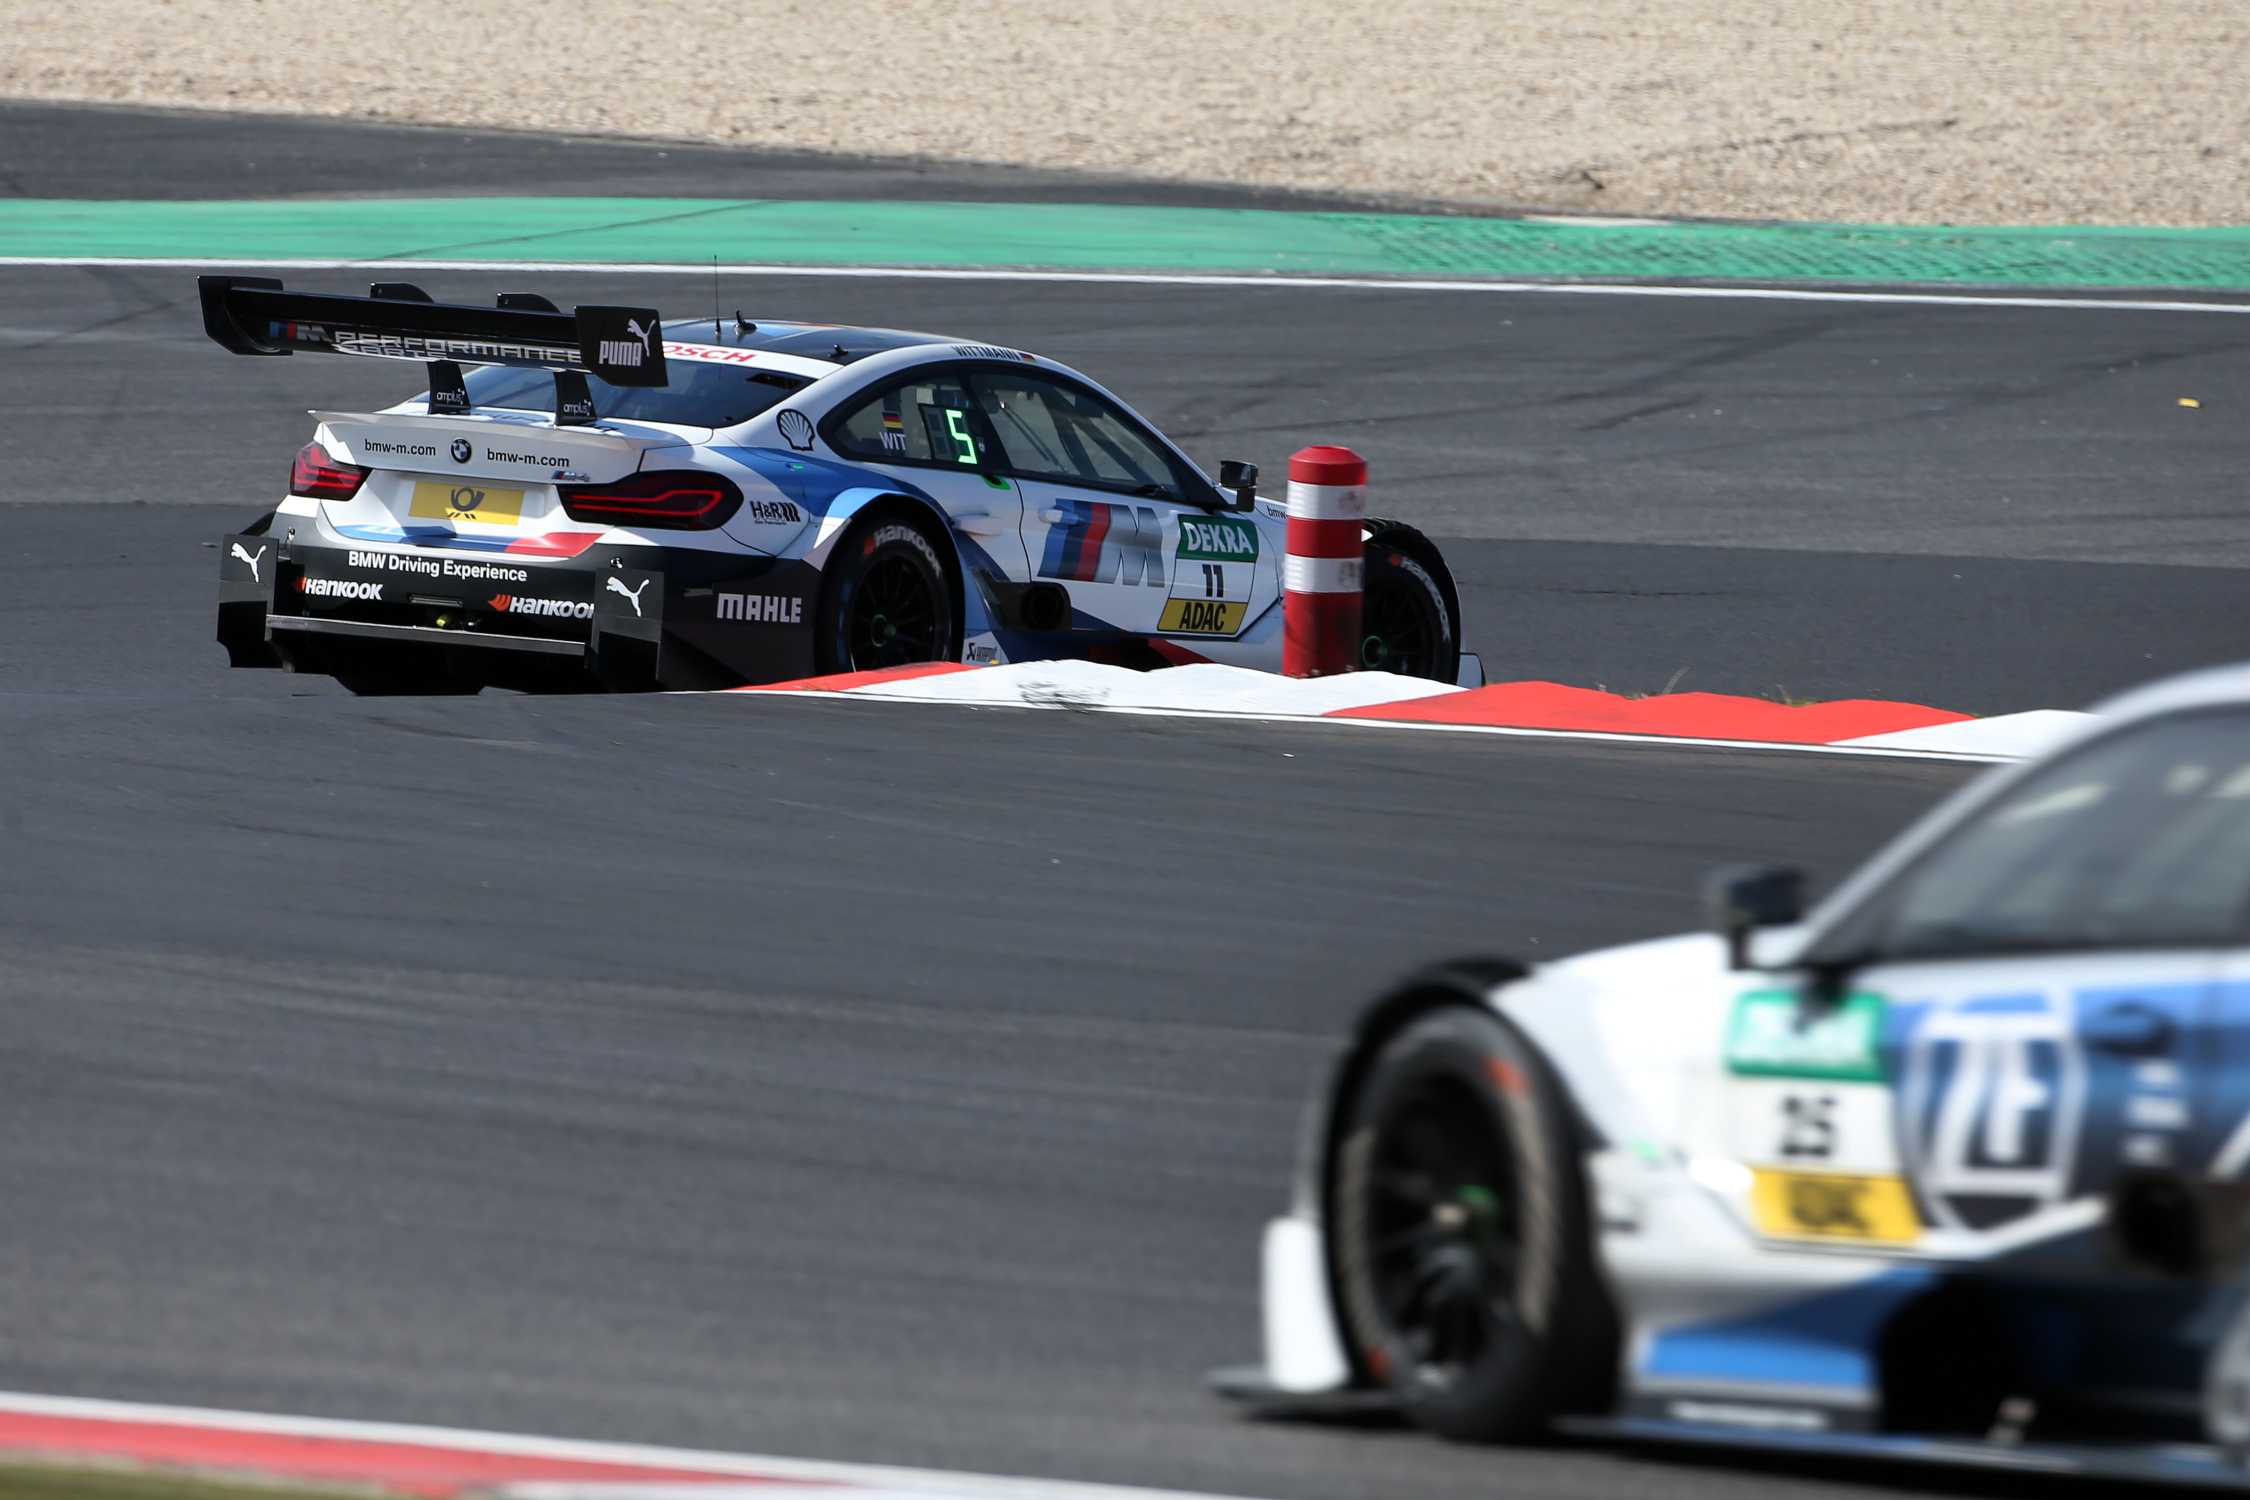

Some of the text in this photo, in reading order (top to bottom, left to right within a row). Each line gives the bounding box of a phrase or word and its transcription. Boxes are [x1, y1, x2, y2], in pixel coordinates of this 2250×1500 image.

[335, 331, 582, 363] PERFORMANCE
[599, 340, 643, 367] PUMA
[661, 345, 758, 362] OSCH
[951, 343, 1021, 361] WITTMANN
[364, 439, 436, 457] bmw-m.com
[879, 431, 906, 451] WIT
[945, 409, 978, 465] 5
[487, 448, 570, 468] bmw-m.com
[750, 500, 783, 519] H&R
[1185, 519, 1255, 555] DEKRA
[348, 550, 528, 582] BMW Driving Experience
[1201, 563, 1225, 598] 11
[717, 593, 802, 624] MAHLE
[1178, 600, 1227, 632] ADAC
